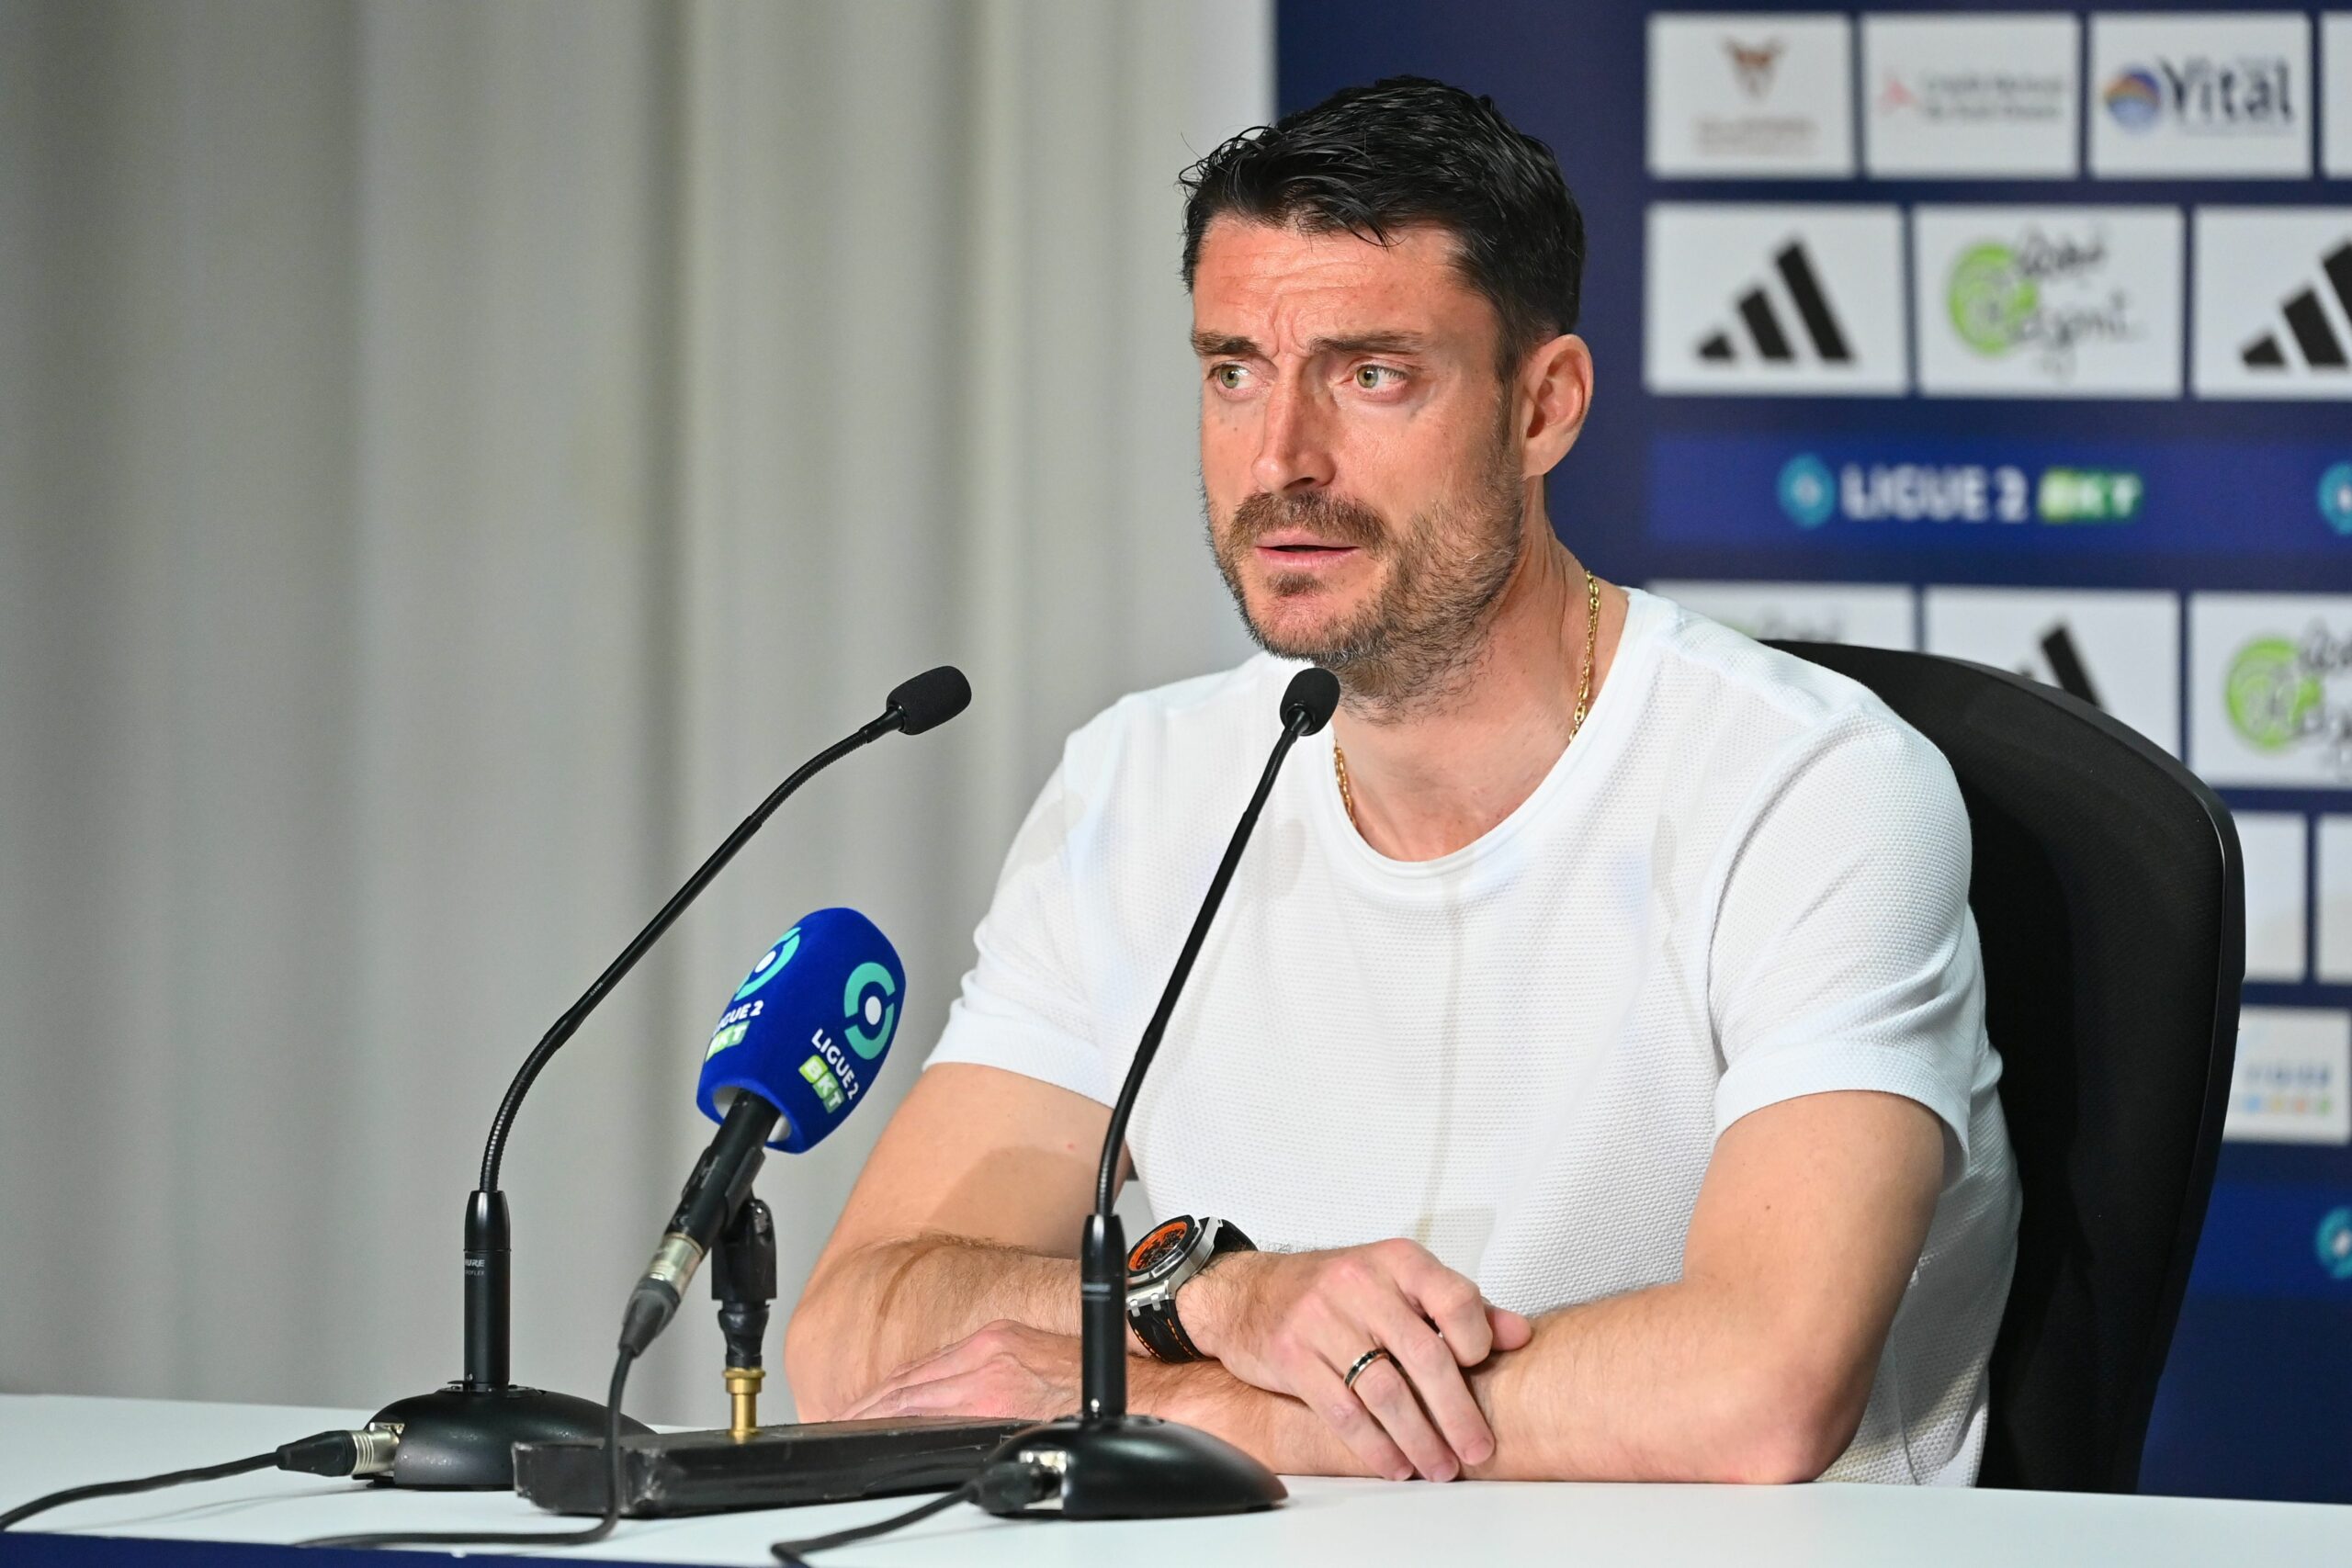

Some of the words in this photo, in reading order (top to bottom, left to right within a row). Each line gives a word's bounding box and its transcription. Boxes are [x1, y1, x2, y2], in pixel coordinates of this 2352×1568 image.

[1841, 465, 1987, 521] LIGUE
[1994, 466, 2028, 522] 2
[750, 999, 763, 1017] 2
[802, 1057, 843, 1109] BKT
[811, 1028, 854, 1089] LIGUE
[847, 1082, 859, 1100] 2
